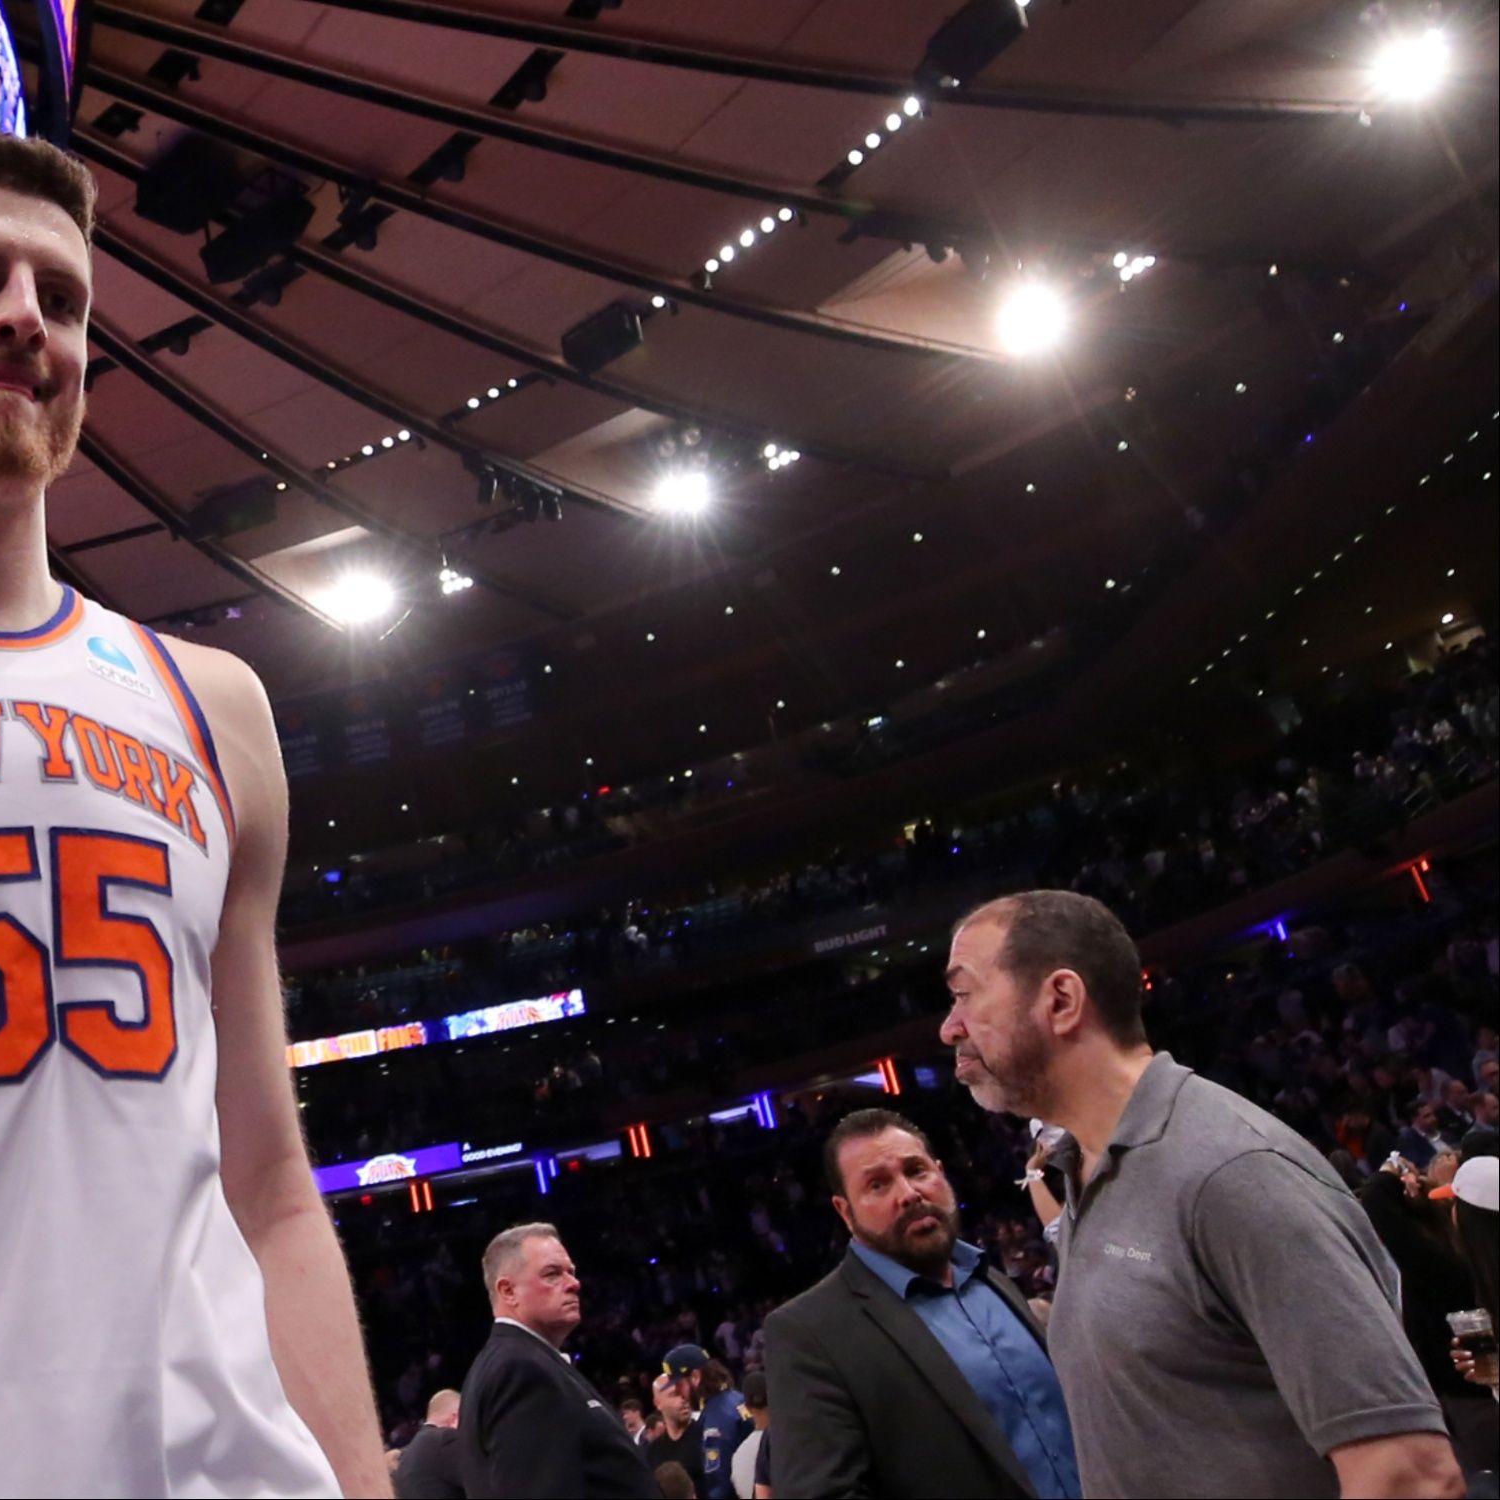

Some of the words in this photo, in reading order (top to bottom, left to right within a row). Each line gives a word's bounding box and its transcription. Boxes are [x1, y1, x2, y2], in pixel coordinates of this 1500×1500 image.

[3, 700, 209, 857] YORK
[815, 937, 845, 952] BUD
[845, 925, 887, 945] LIGHT
[461, 1150, 487, 1163] GOOD
